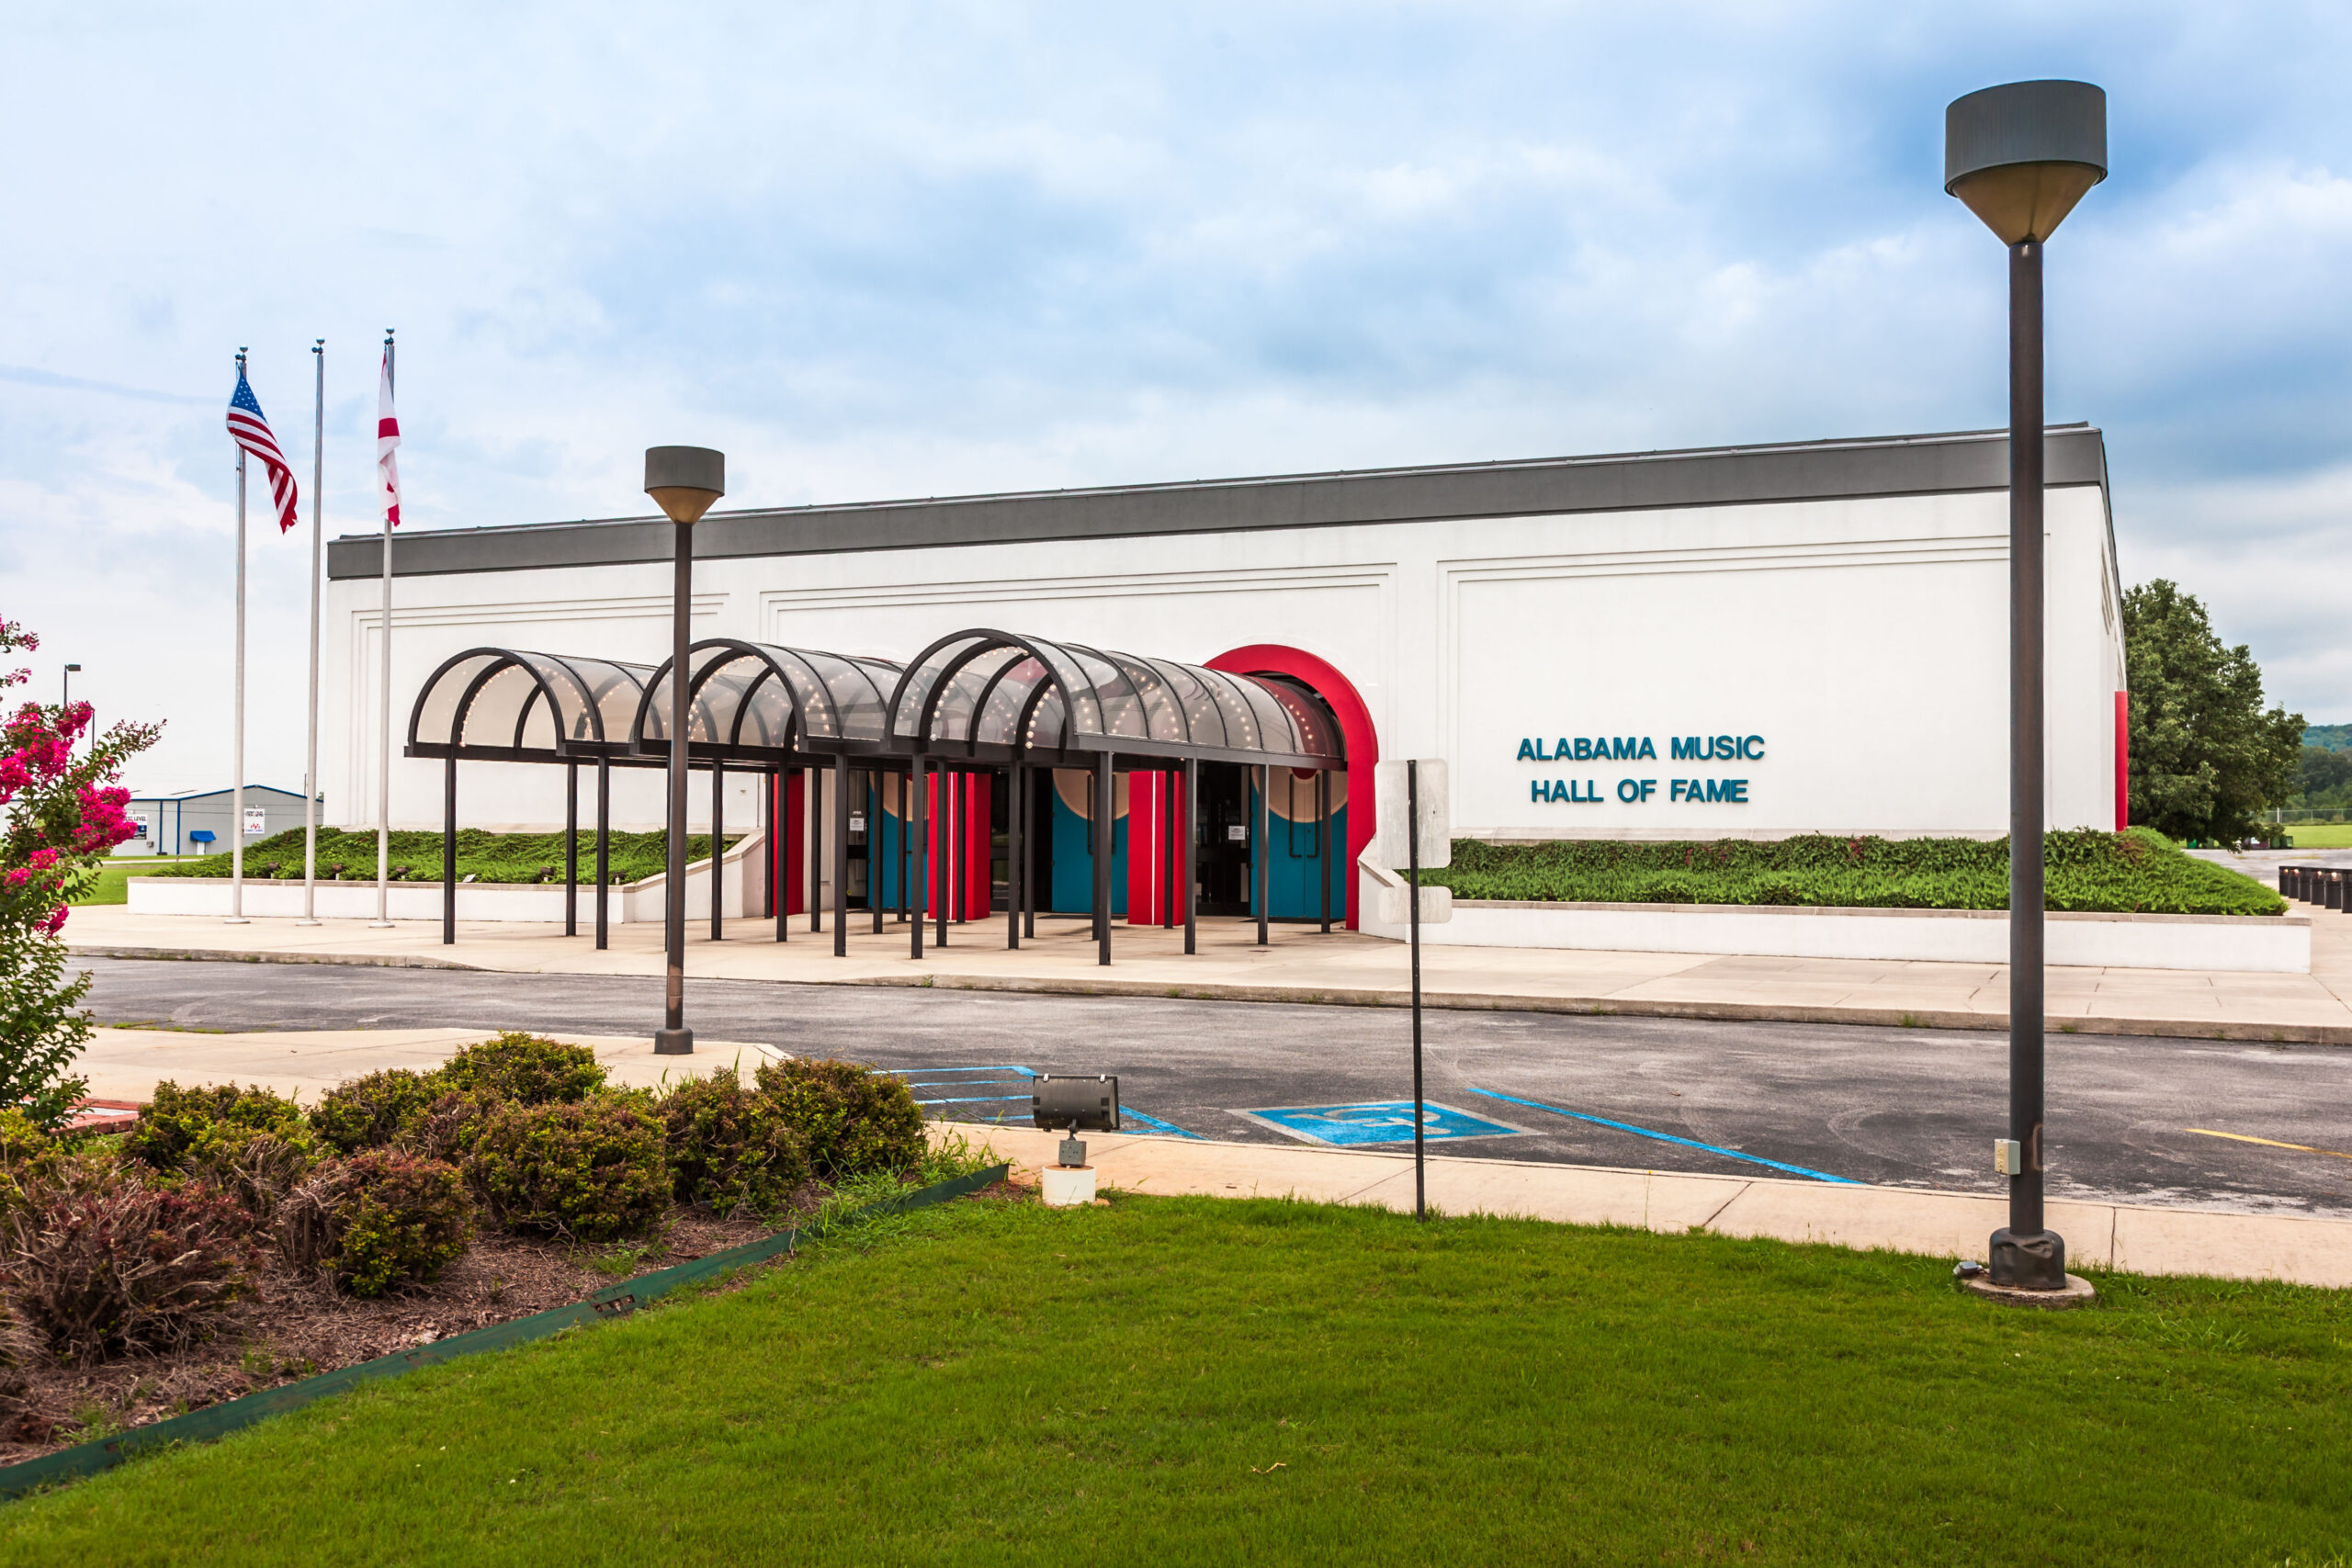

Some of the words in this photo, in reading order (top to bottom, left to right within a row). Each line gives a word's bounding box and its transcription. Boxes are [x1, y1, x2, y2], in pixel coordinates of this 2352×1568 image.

[1517, 736, 1657, 761] ALABAMA
[1670, 735, 1765, 760] MUSIC
[1531, 779, 1604, 802] HALL
[1617, 778, 1657, 803] OF
[1670, 779, 1749, 802] FAME
